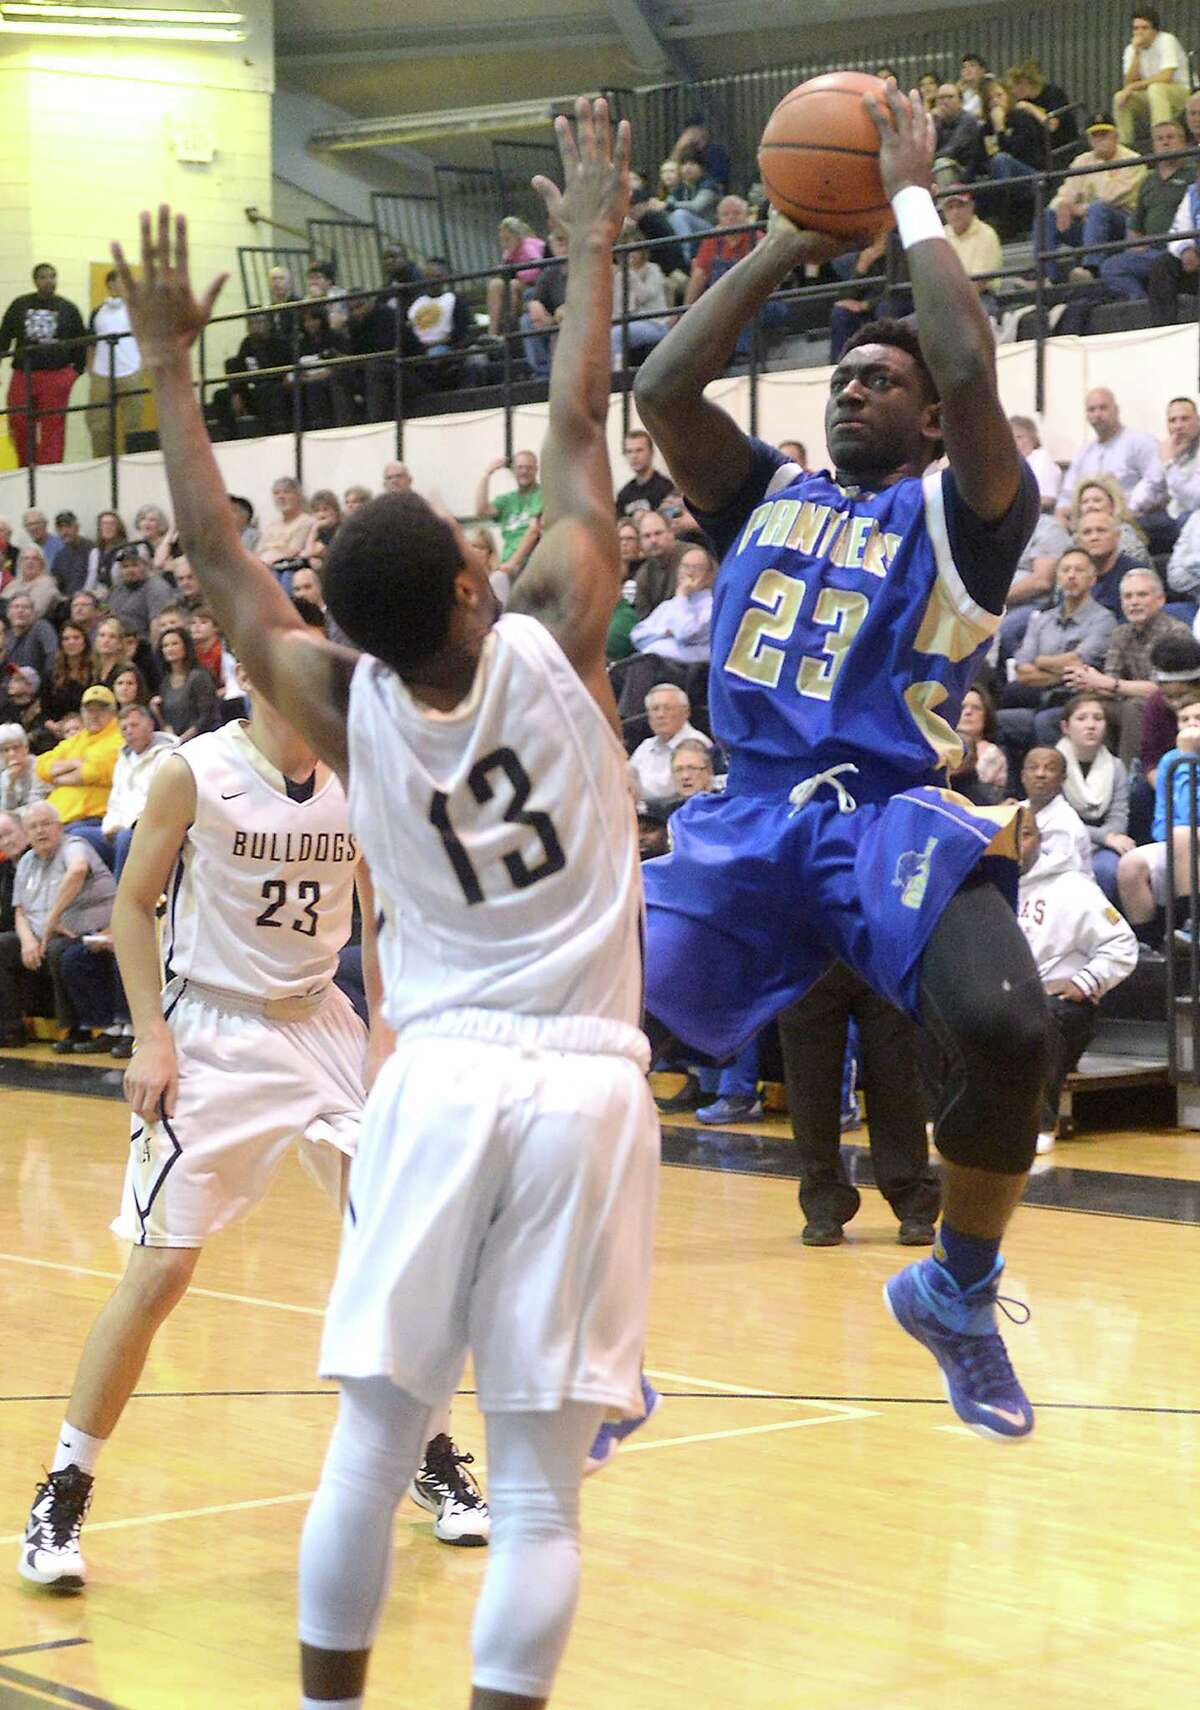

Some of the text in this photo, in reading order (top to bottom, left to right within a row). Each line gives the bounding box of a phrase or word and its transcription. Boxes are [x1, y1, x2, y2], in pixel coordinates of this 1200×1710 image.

[724, 568, 870, 701] 23
[233, 831, 356, 862] BULLDOGS
[430, 748, 566, 905] 13
[256, 880, 320, 937] 23
